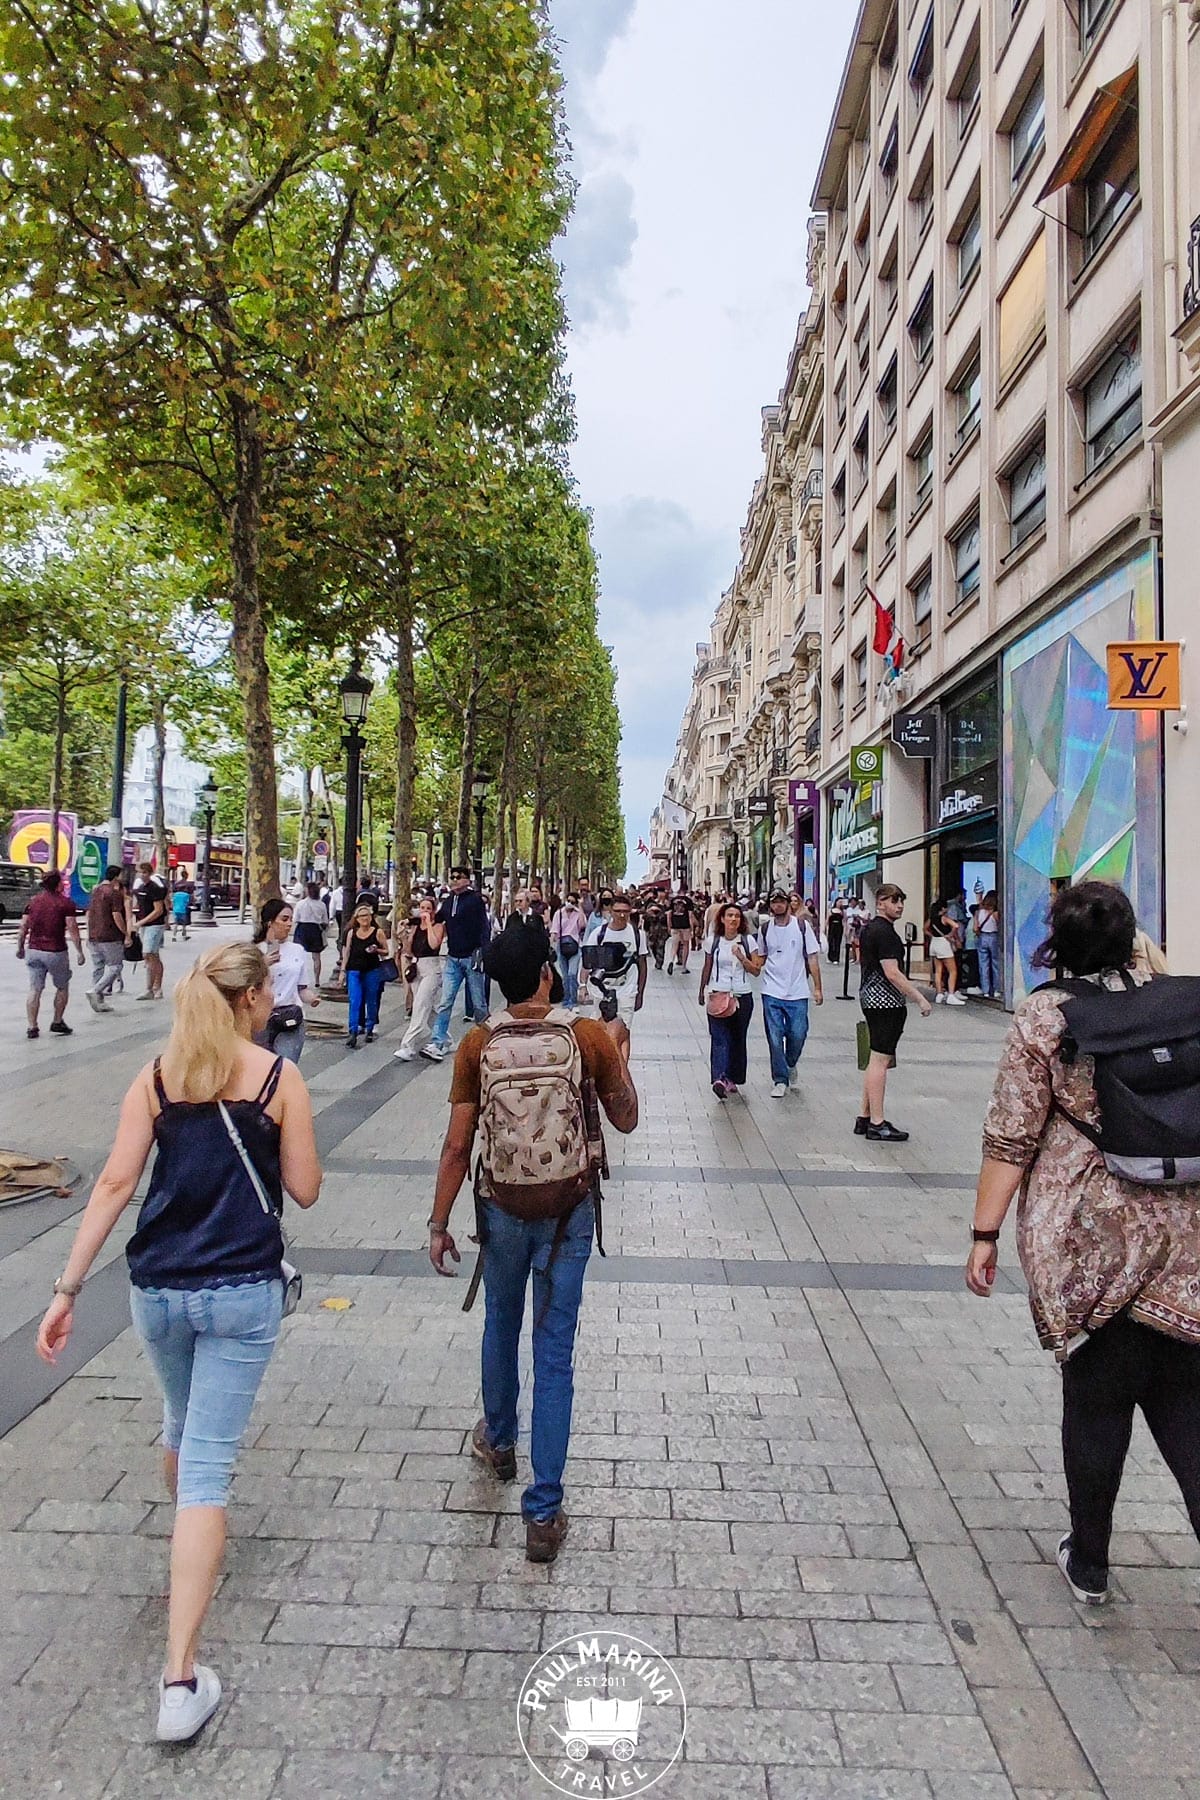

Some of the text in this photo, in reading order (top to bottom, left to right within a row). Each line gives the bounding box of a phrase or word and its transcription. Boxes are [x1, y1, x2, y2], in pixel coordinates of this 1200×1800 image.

[1118, 652, 1168, 699] LV
[906, 719, 922, 729] Jeff
[901, 732, 930, 743] Bruges
